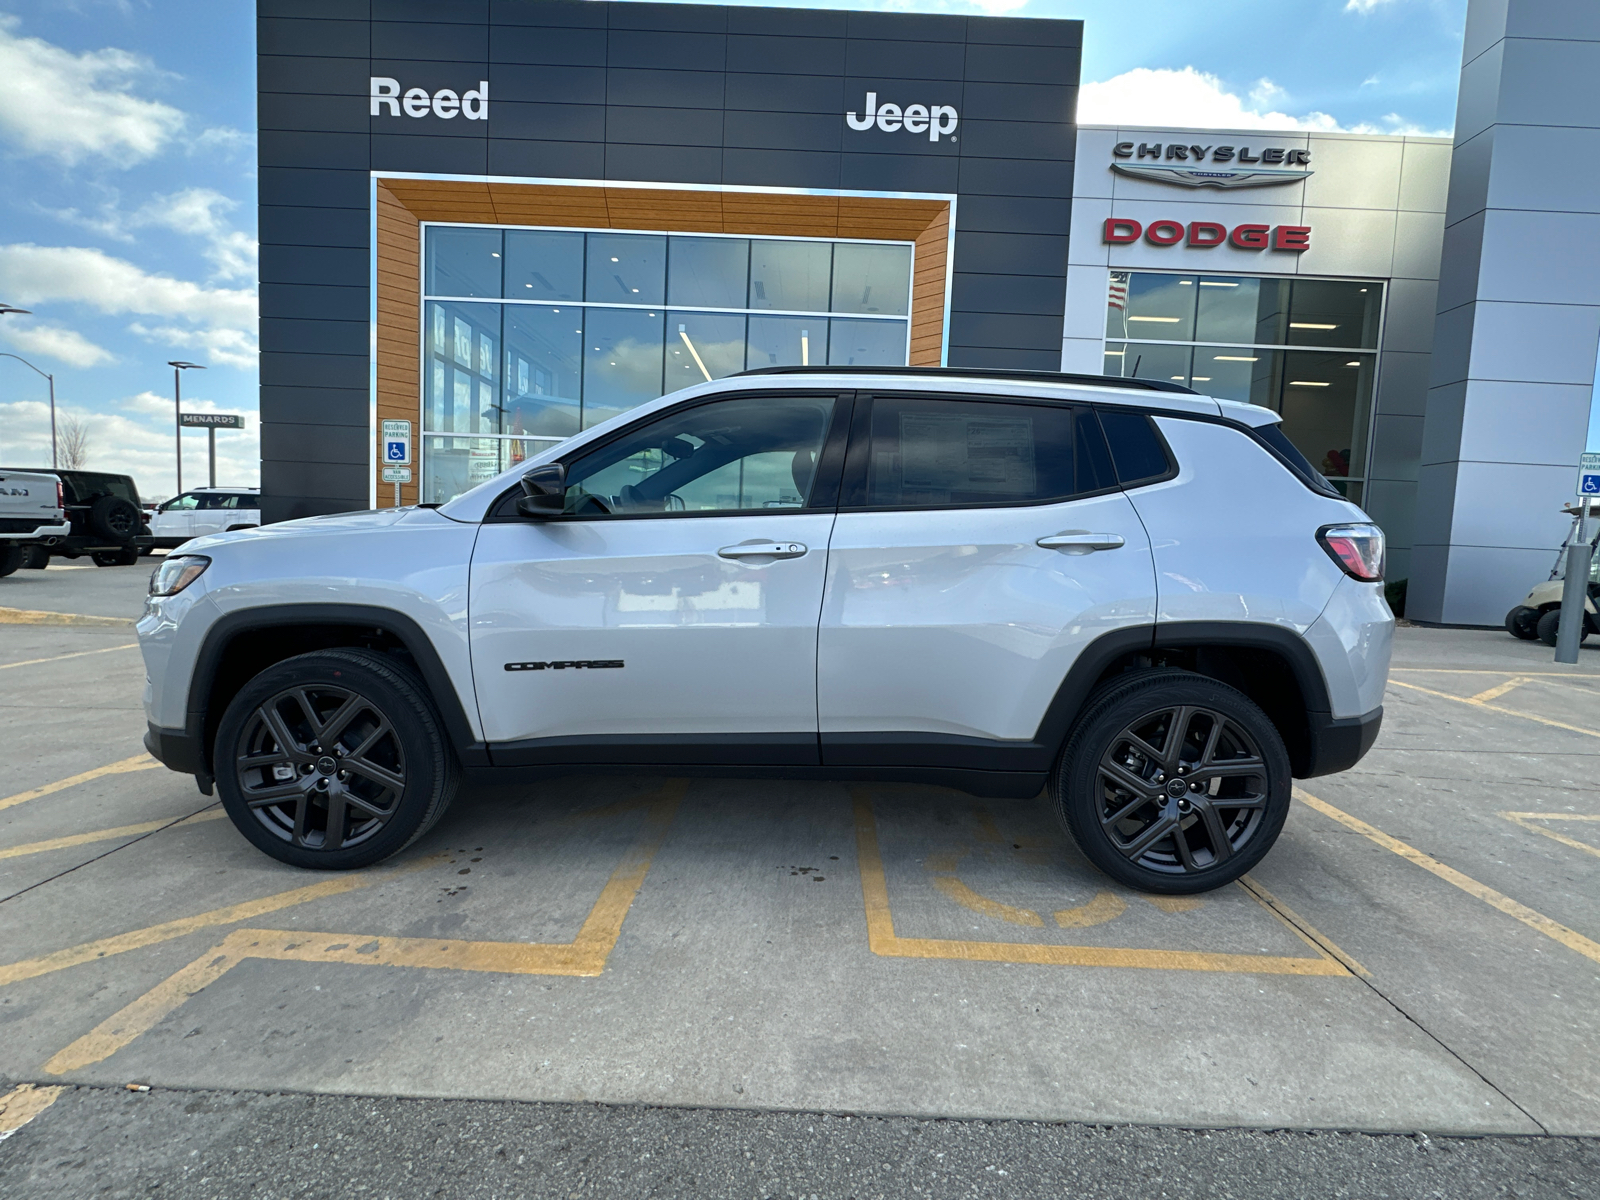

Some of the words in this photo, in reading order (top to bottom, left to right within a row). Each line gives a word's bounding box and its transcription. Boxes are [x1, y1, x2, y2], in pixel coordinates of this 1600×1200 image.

[369, 76, 489, 120] Reed
[846, 92, 958, 142] Jeep
[1112, 141, 1312, 165] CHRYSLER
[1103, 218, 1312, 252] DODGE
[183, 414, 235, 424] MENARDS
[384, 423, 408, 431] RESERVED
[504, 659, 625, 671] COMPASS
